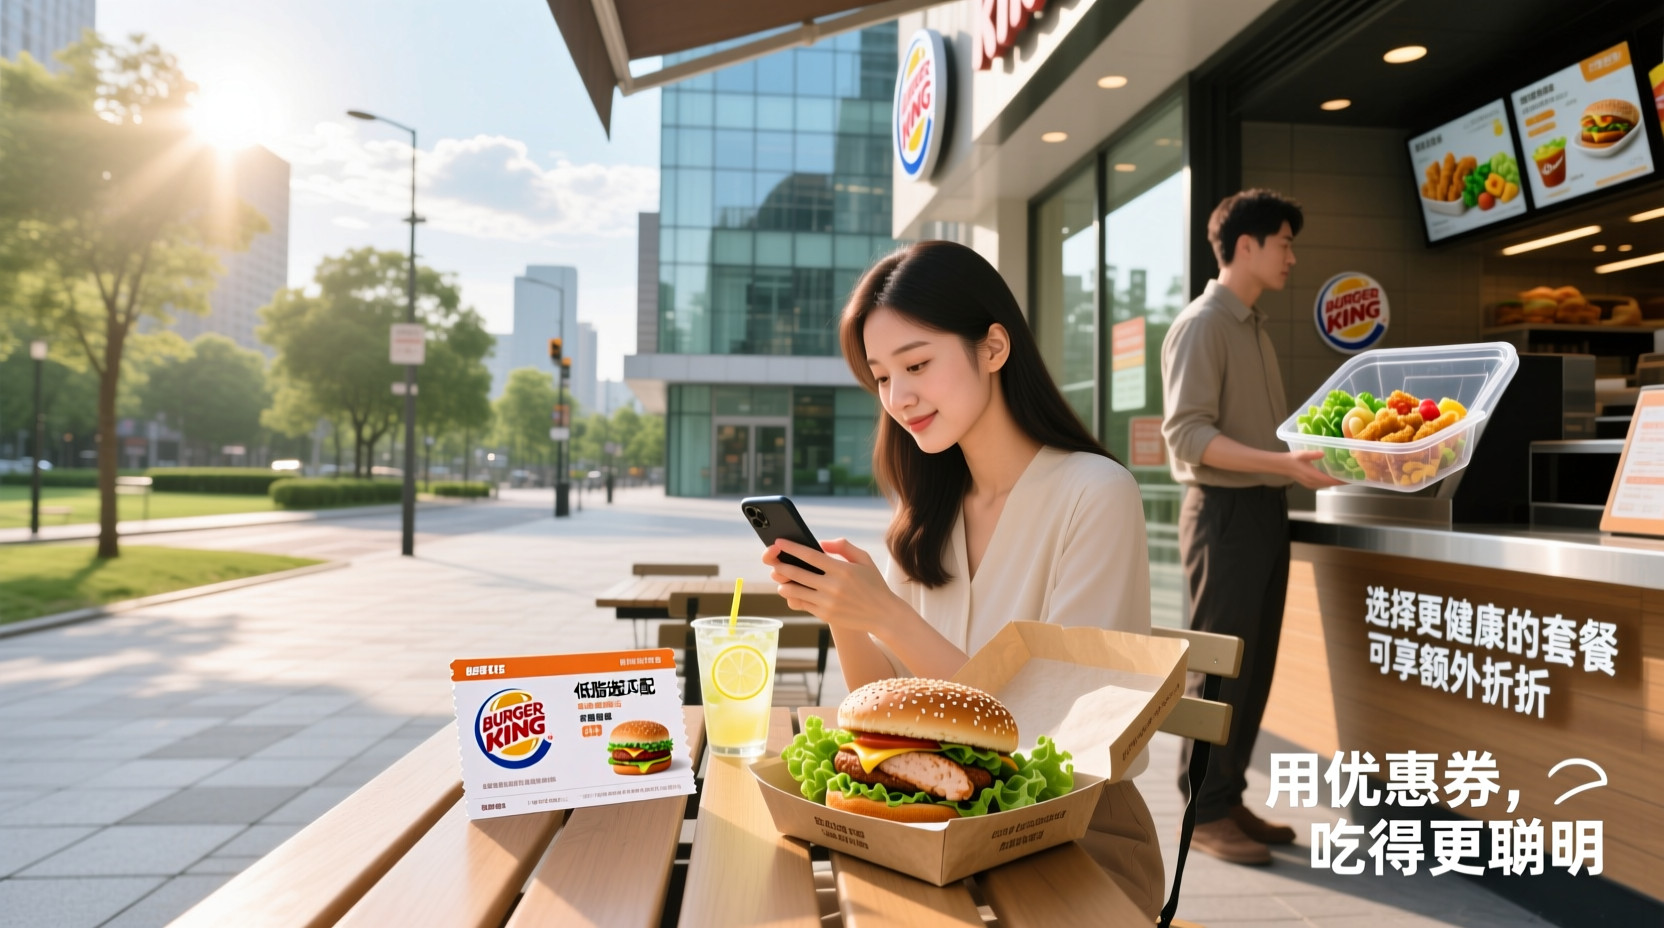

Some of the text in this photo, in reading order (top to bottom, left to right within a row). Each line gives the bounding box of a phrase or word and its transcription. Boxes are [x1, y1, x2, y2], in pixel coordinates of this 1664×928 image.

[902, 80, 931, 151] KING
[1325, 287, 1379, 314] BURGER
[1327, 300, 1381, 335] KING
[1365, 585, 1619, 677] 选择更健康的套餐
[1367, 631, 1551, 719] 可享额外折折
[482, 701, 546, 733] BURGER
[486, 715, 546, 753] KING
